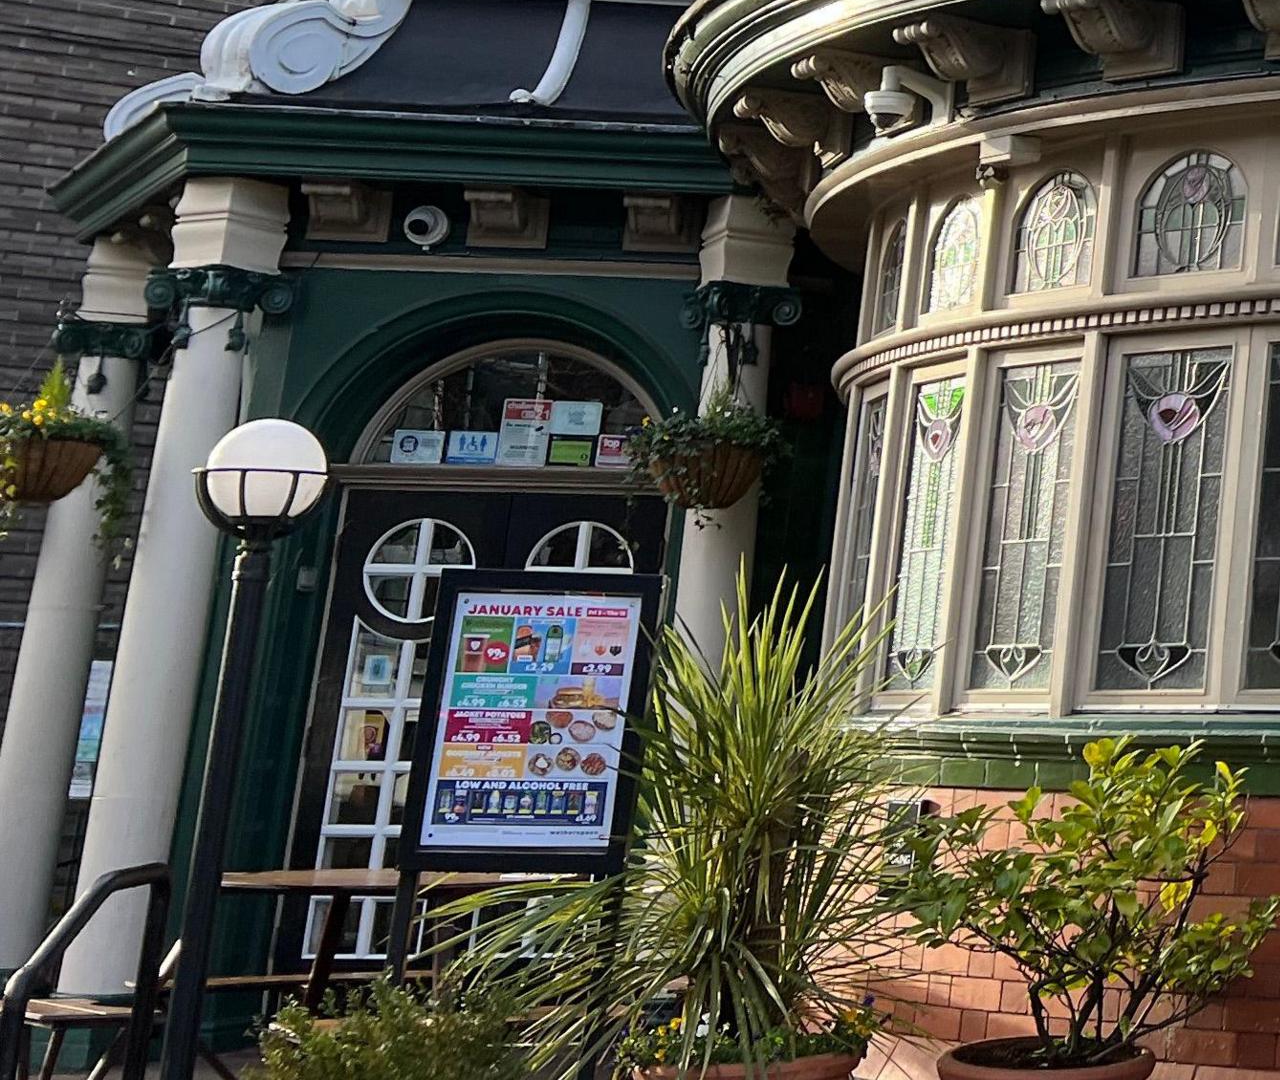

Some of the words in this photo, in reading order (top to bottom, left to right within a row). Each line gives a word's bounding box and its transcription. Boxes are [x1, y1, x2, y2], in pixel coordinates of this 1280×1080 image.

[468, 604, 543, 616] JANUARY
[546, 606, 583, 617] SALE
[487, 648, 505, 659] 99p
[451, 733, 480, 742] £4.99
[455, 781, 481, 789] LOW
[482, 781, 507, 790] AND
[509, 782, 561, 791] ALCOHOL
[563, 782, 589, 791] FREE
